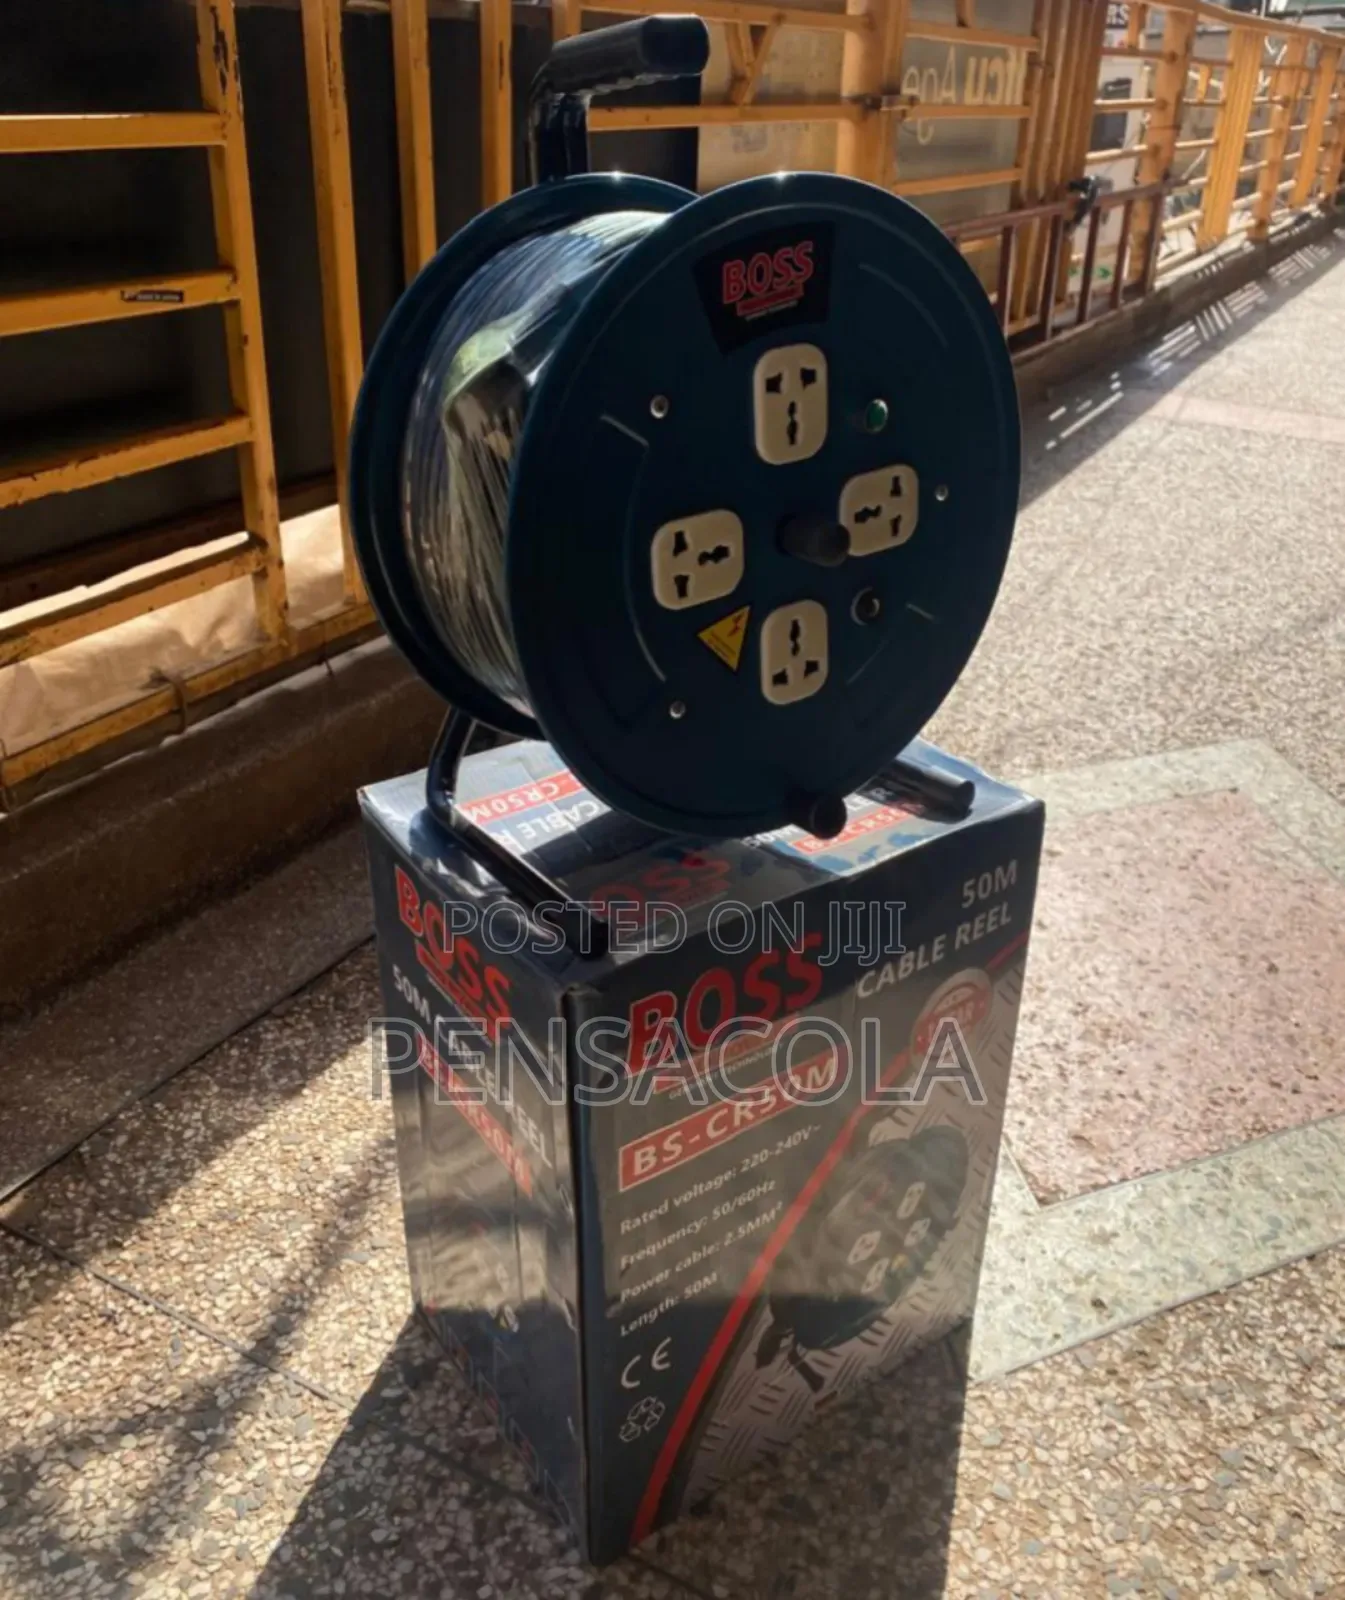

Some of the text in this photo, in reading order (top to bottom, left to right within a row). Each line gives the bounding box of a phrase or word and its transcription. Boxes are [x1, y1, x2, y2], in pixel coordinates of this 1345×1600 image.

[722, 240, 814, 304] BOSS
[516, 800, 600, 839] CABLE
[961, 859, 1018, 909] 50M
[395, 863, 512, 1030] BOSS
[857, 902, 1012, 998] CABLE REEL
[393, 964, 431, 1025] 50M
[626, 932, 822, 1078] BOSS
[632, 1057, 836, 1176] BS-CR50M
[620, 1198, 670, 1235] Rated
[672, 1167, 737, 1208] voltage:
[620, 1179, 776, 1271] Frequency: 50/60Hz
[620, 1269, 671, 1303] Power
[675, 1241, 721, 1273] cable:
[620, 1271, 719, 1338] Length: 50M
